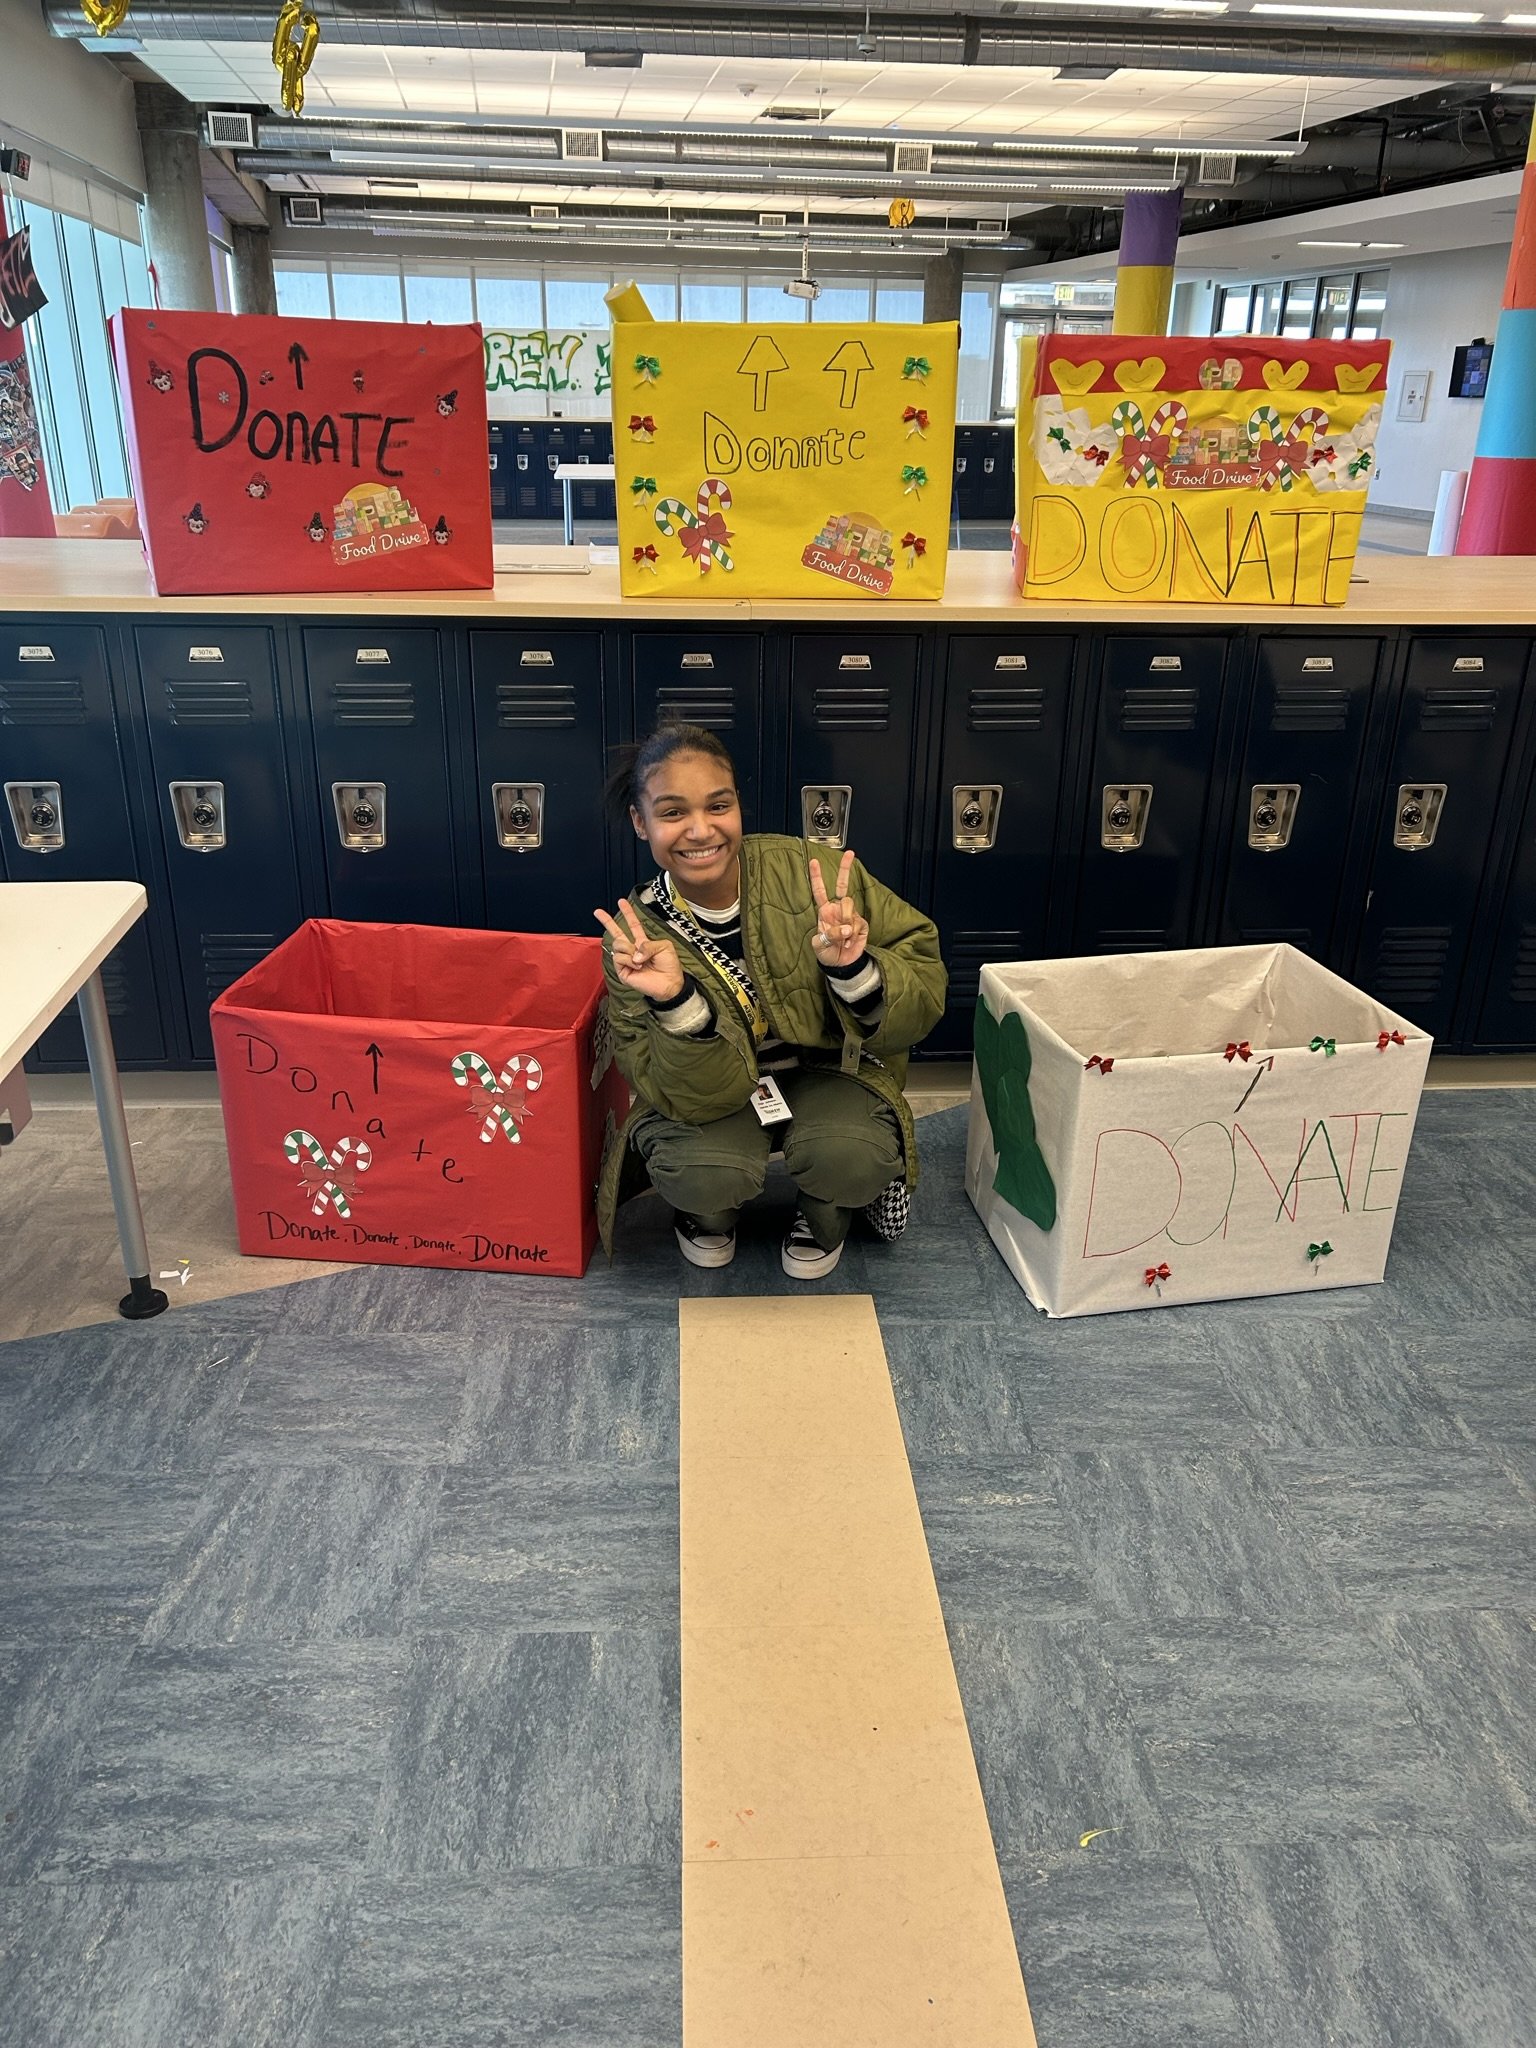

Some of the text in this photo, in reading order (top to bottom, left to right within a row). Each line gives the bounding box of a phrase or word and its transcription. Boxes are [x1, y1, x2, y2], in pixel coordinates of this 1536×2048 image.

[703, 410, 866, 475] Donate
[1169, 468, 1252, 486] Food Drive
[340, 532, 422, 560] Food Drive
[1025, 495, 1364, 606] DONATE
[808, 550, 884, 590] Food Drive
[27, 646, 43, 655] 3075
[197, 648, 213, 656] 3076
[848, 656, 863, 664] 3080
[1083, 1113, 1409, 1258] DONATE
[462, 1235, 550, 1263] Donate
